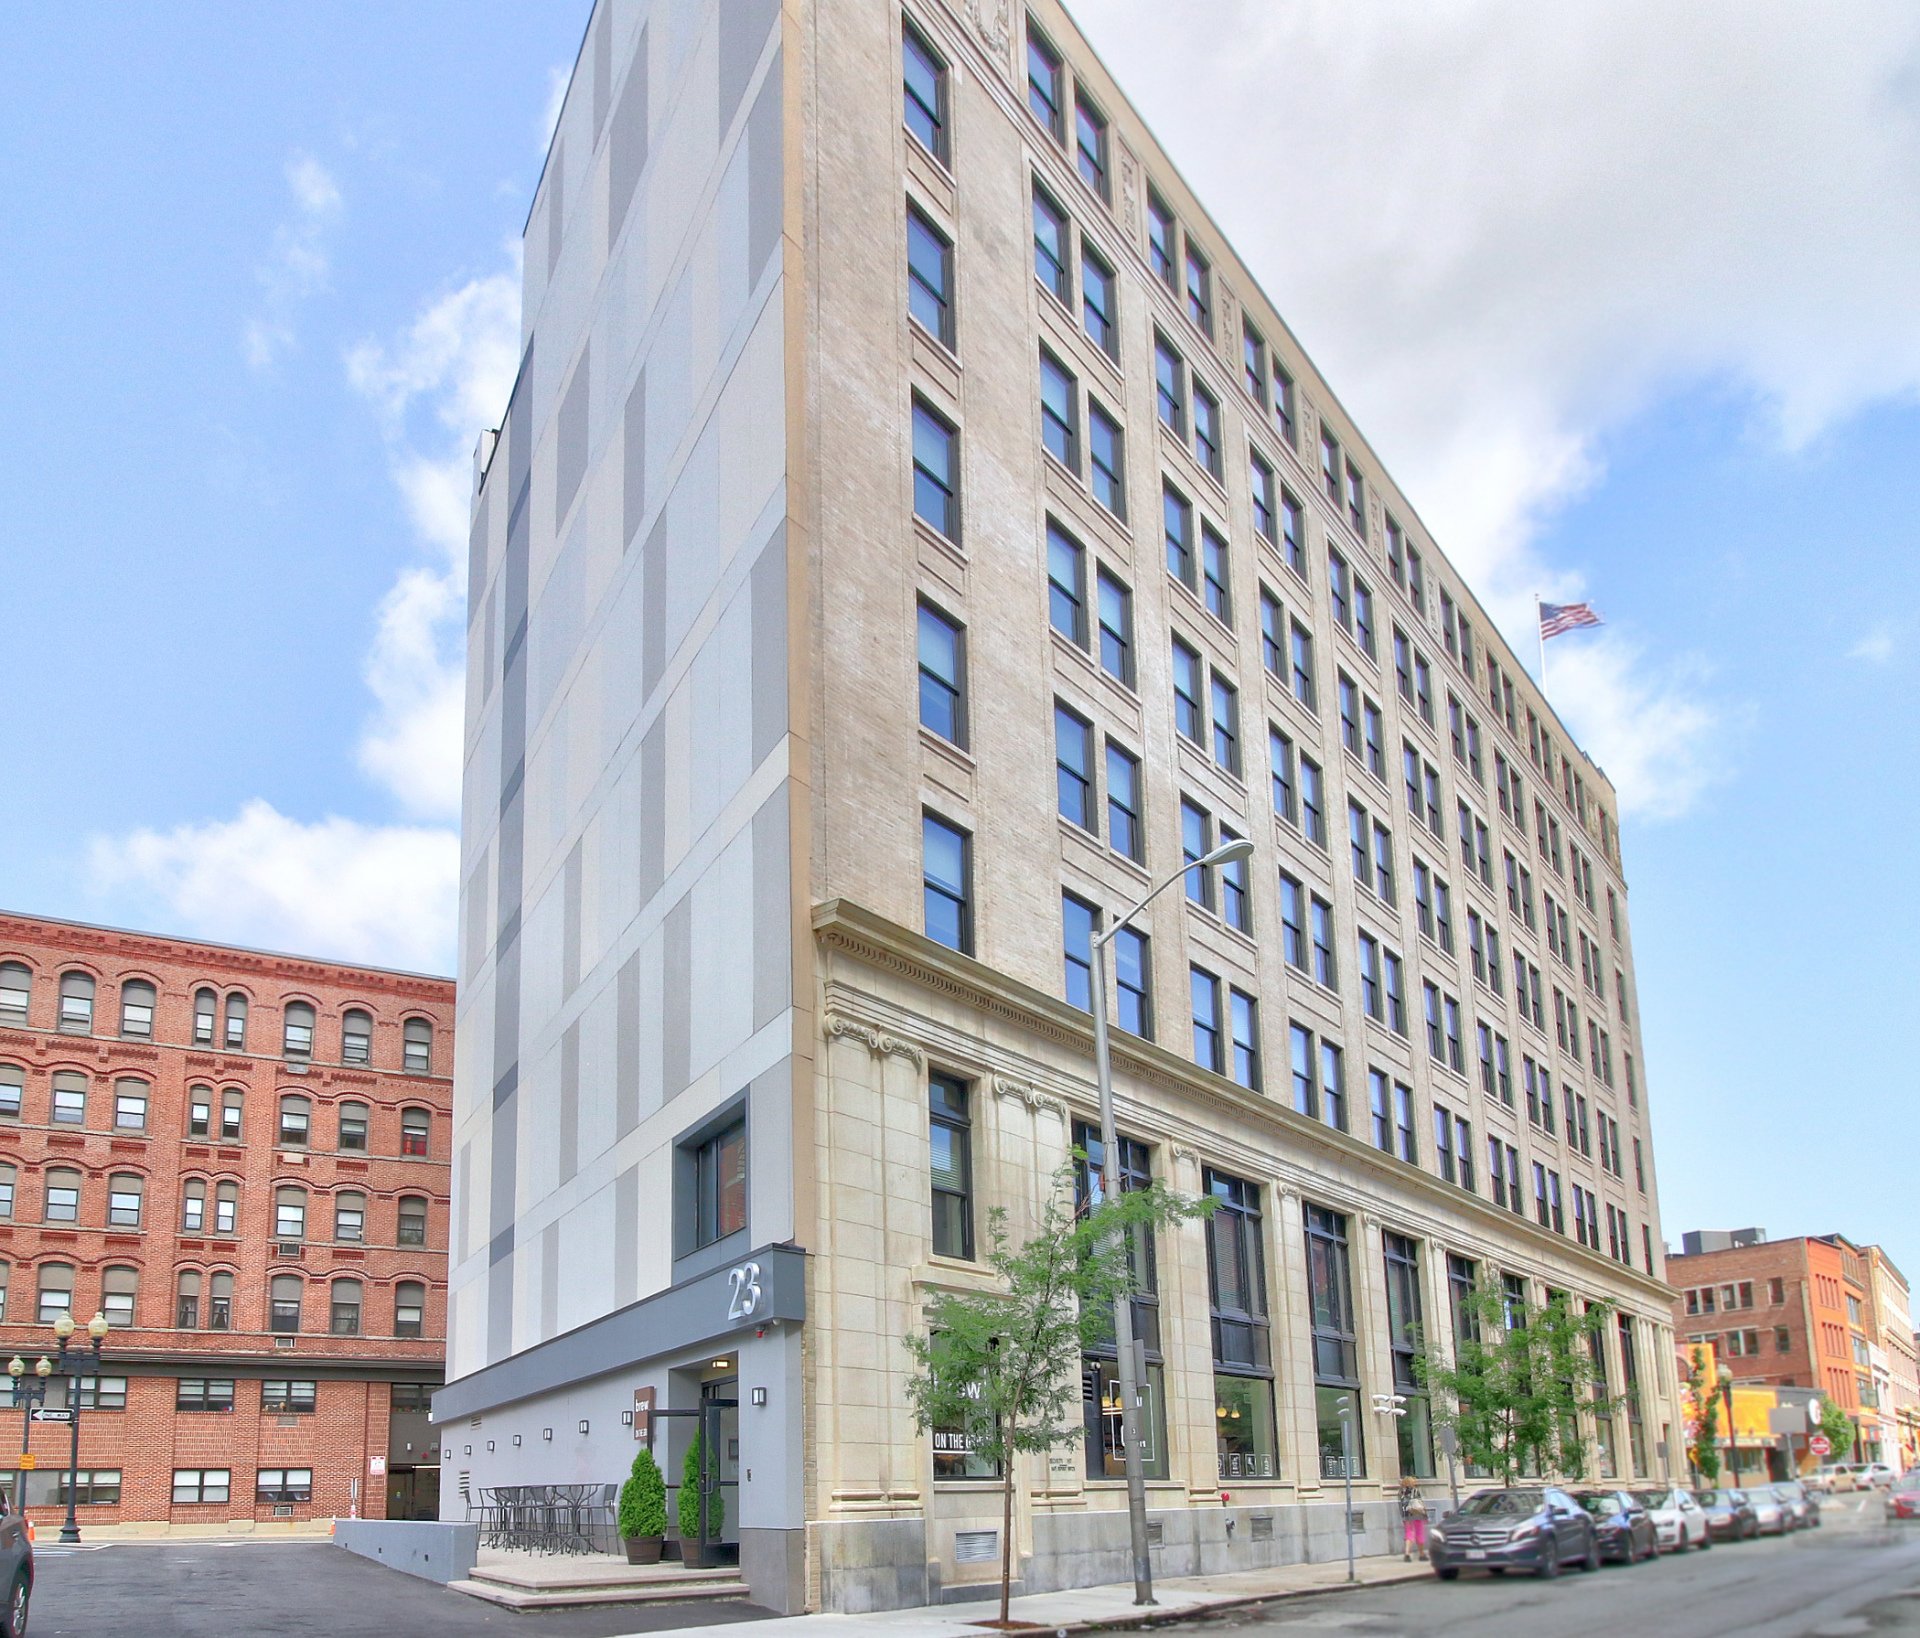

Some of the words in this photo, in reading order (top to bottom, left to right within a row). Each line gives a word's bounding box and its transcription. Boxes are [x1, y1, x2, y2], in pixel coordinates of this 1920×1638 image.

[728, 1262, 761, 1320] 23
[636, 1399, 649, 1412] brew
[934, 1432, 947, 1449] ON
[948, 1433, 964, 1449] THE
